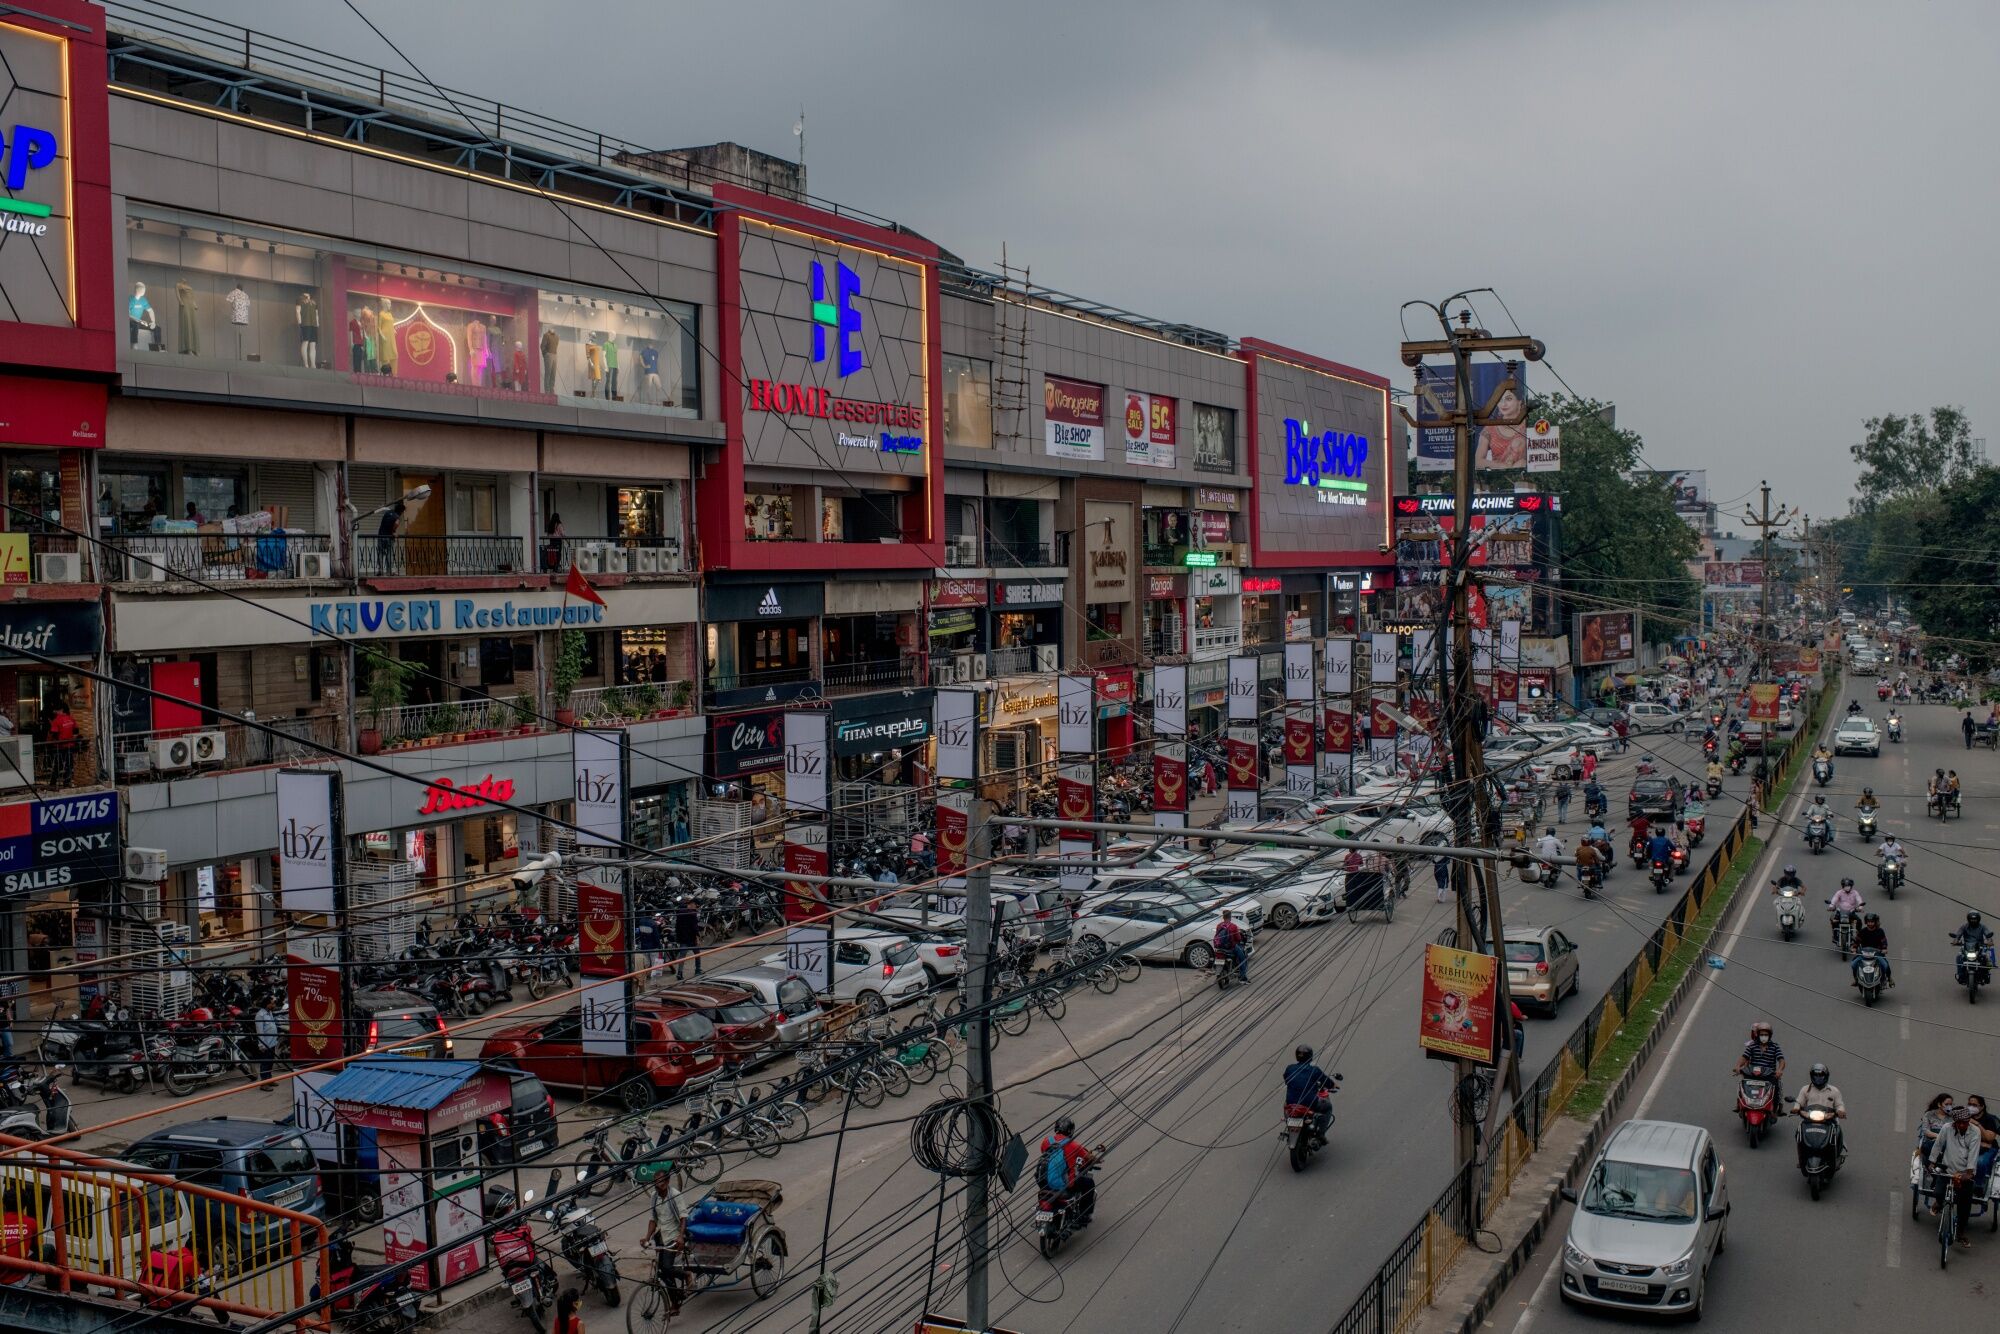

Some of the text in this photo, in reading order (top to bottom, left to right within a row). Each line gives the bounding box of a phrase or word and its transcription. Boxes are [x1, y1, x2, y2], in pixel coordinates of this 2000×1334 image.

[751, 379, 832, 419] HOME
[1128, 418, 1143, 431] SALE
[1129, 409, 1141, 420] BIG
[838, 432, 868, 448] Powered
[869, 436, 878, 450] by
[1054, 424, 1092, 446] Big SHOP
[1428, 435, 1456, 443] JEWELL
[1527, 437, 1559, 449] ABHUSHAN
[1284, 418, 1368, 487] Big SHOP
[1528, 453, 1559, 464] JEWELLERS
[1472, 497, 1515, 510] ACHINE
[948, 579, 976, 598] Gayatri
[1006, 583, 1064, 604] SHREE PRABHAT
[310, 598, 603, 636] KAVERI Restaurant
[759, 605, 782, 616] adidas
[1327, 658, 1349, 674] tbz
[1373, 649, 1394, 664] tbz
[1287, 663, 1310, 680] tbz
[1230, 678, 1255, 697] tbz
[1031, 691, 1058, 710] Jeweller
[1155, 688, 1182, 709] tbz
[1061, 702, 1088, 725] tbz
[731, 722, 765, 752] City
[843, 716, 924, 743] TITAN eyeplus
[938, 720, 969, 747] tbz
[739, 758, 764, 768] EXCELLENCE
[786, 744, 822, 775] tbz
[418, 774, 516, 815] Bata
[577, 769, 616, 804] tbz
[40, 798, 110, 826] VOLTAS
[40, 832, 111, 858] SONY
[281, 818, 328, 861] tbz
[4, 866, 72, 893] SALES
[592, 907, 609, 920] 7%
[313, 937, 336, 961] tbz
[788, 943, 823, 973] tbz
[1431, 964, 1489, 983] TRIBHUVAN
[303, 986, 322, 1002] 7%
[583, 997, 621, 1033] tbz
[294, 1091, 336, 1135] tbz
